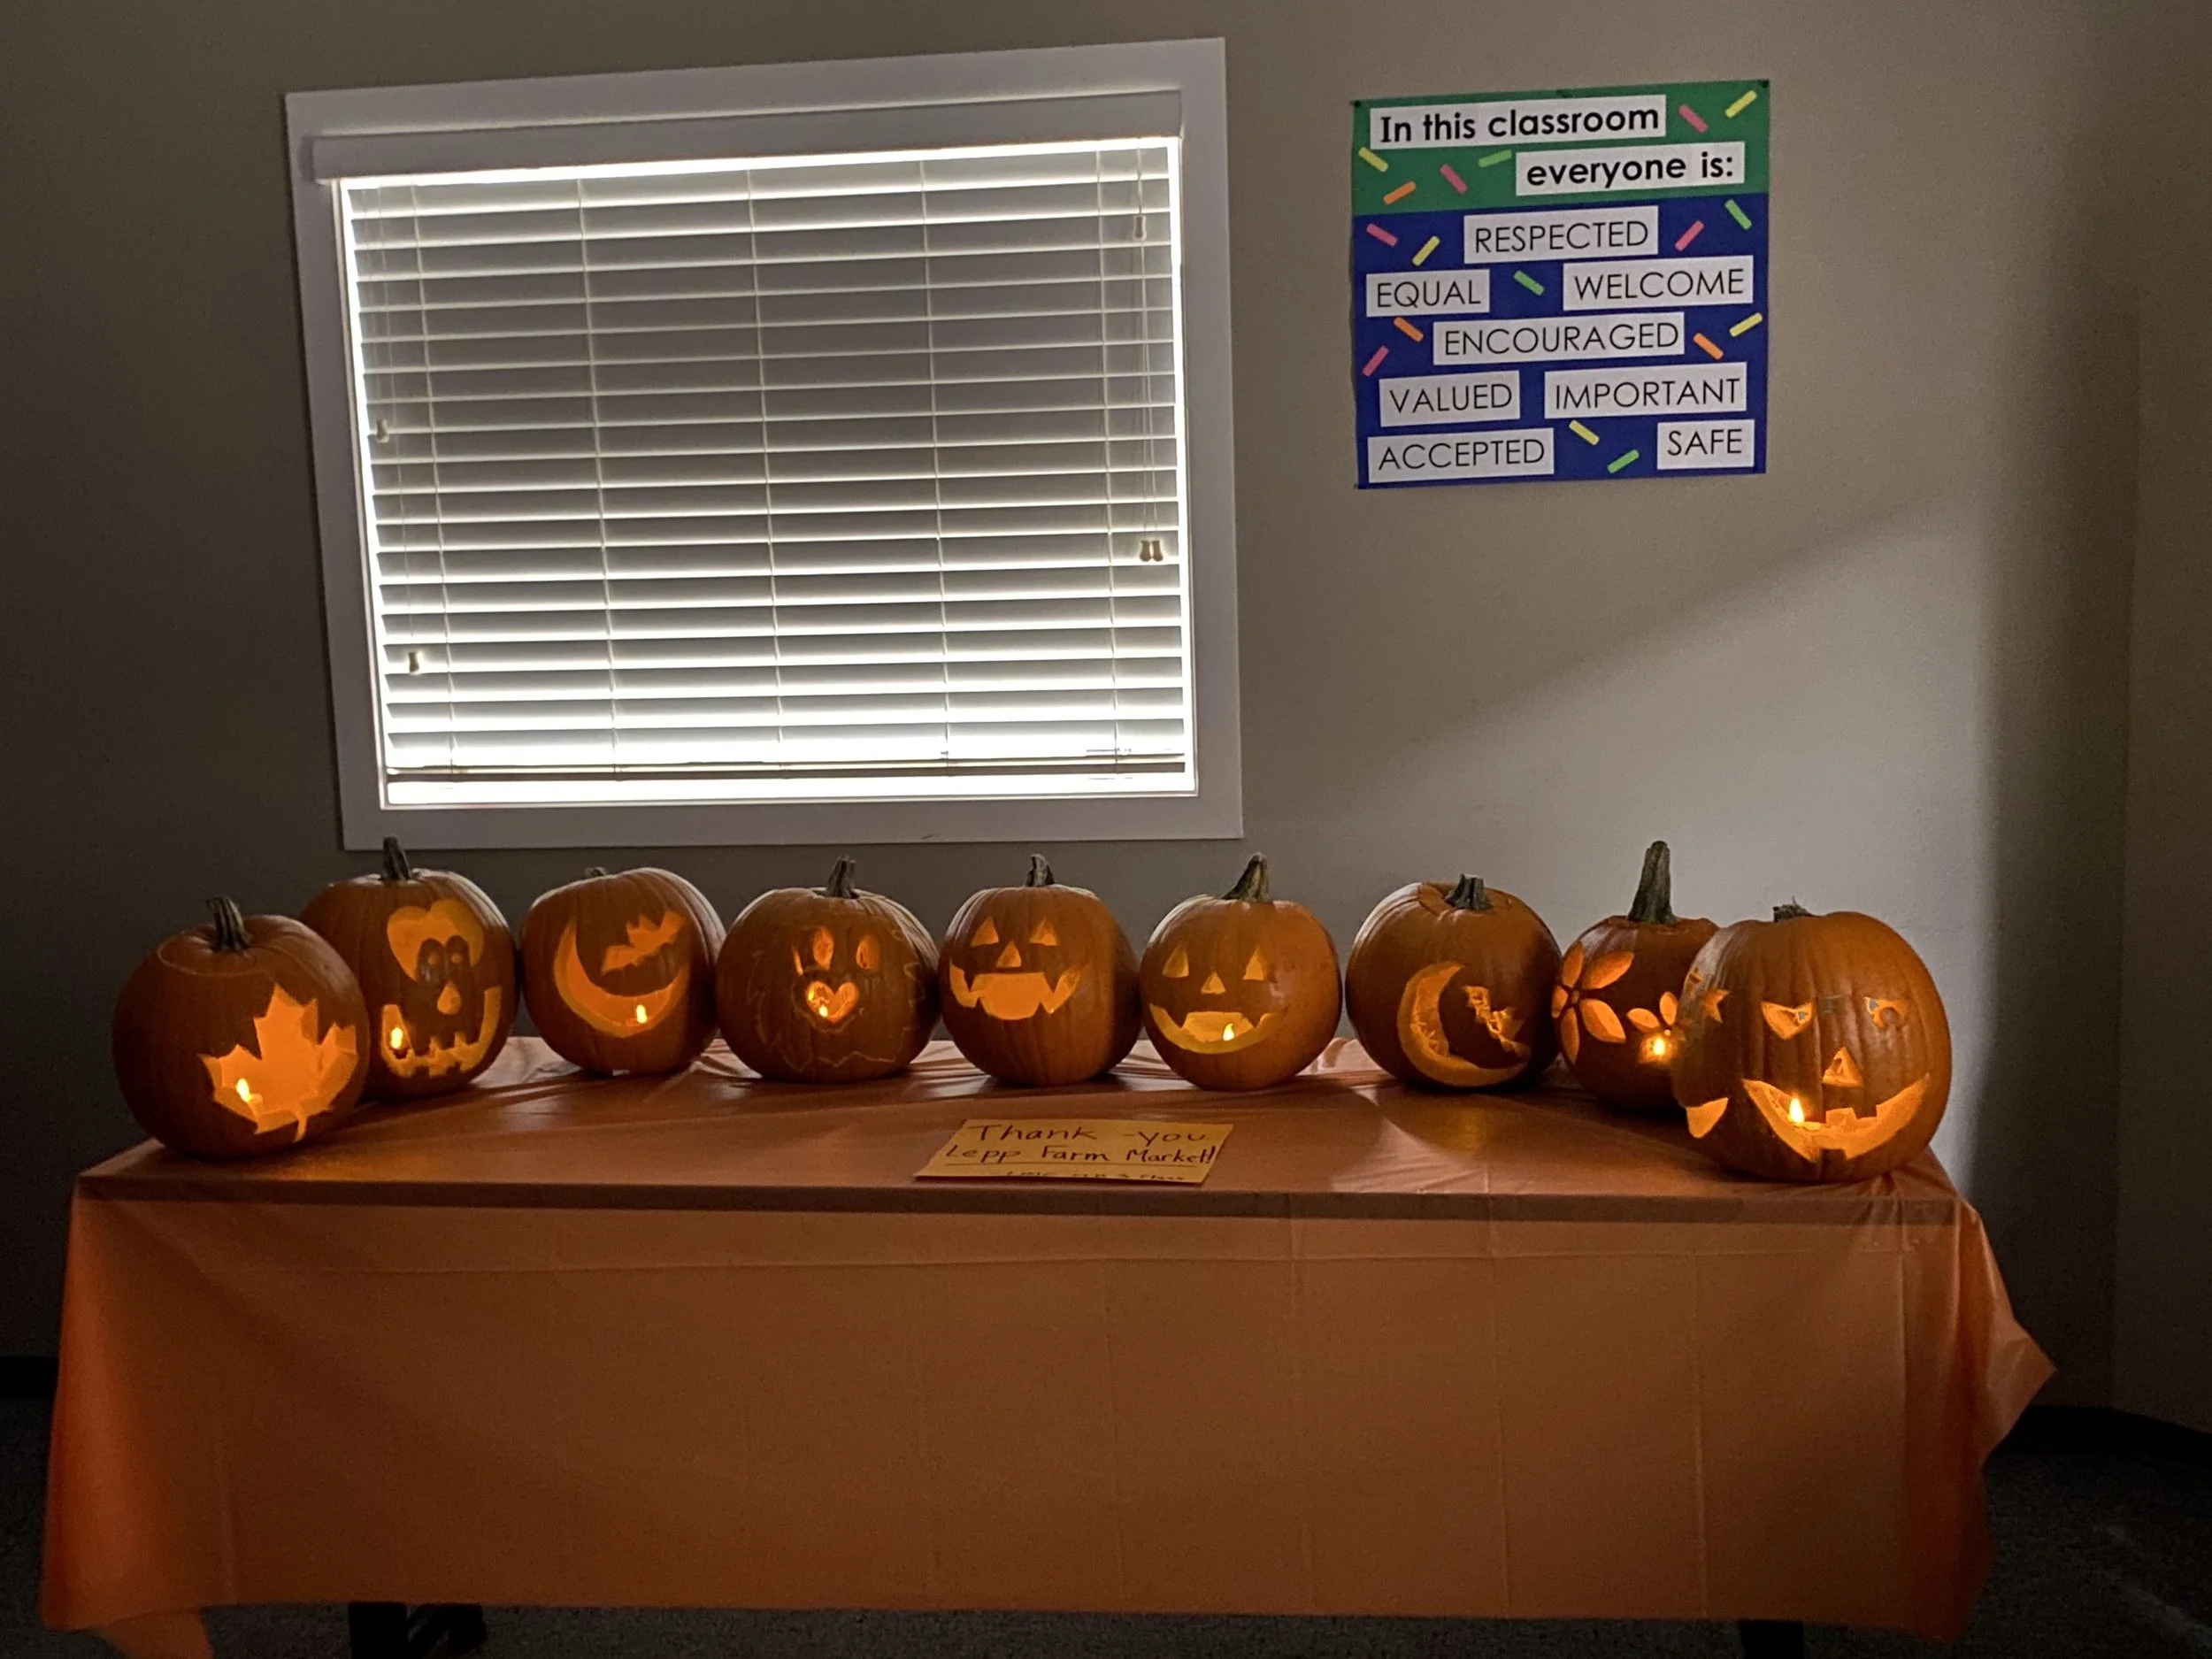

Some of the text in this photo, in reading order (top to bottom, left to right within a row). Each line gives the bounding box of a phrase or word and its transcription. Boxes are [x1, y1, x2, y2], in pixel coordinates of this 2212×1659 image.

[1380, 108, 1660, 142] In this classroom
[1526, 151, 1733, 188] everyone is:
[1475, 220, 1648, 253] RESPECTED
[1377, 281, 1482, 308] EQUAL
[1575, 269, 1744, 301] WELCOME
[1445, 322, 1678, 356] ENCOURAGED
[1390, 383, 1512, 413] VALUED
[1555, 378, 1741, 410] IMPORTANT
[1379, 439, 1545, 472] ACCEPTED
[1667, 429, 1743, 456] SAFE
[968, 1124, 1097, 1141] Thank
[946, 1144, 1021, 1164] Lepp
[1041, 1144, 1110, 1162] Farm
